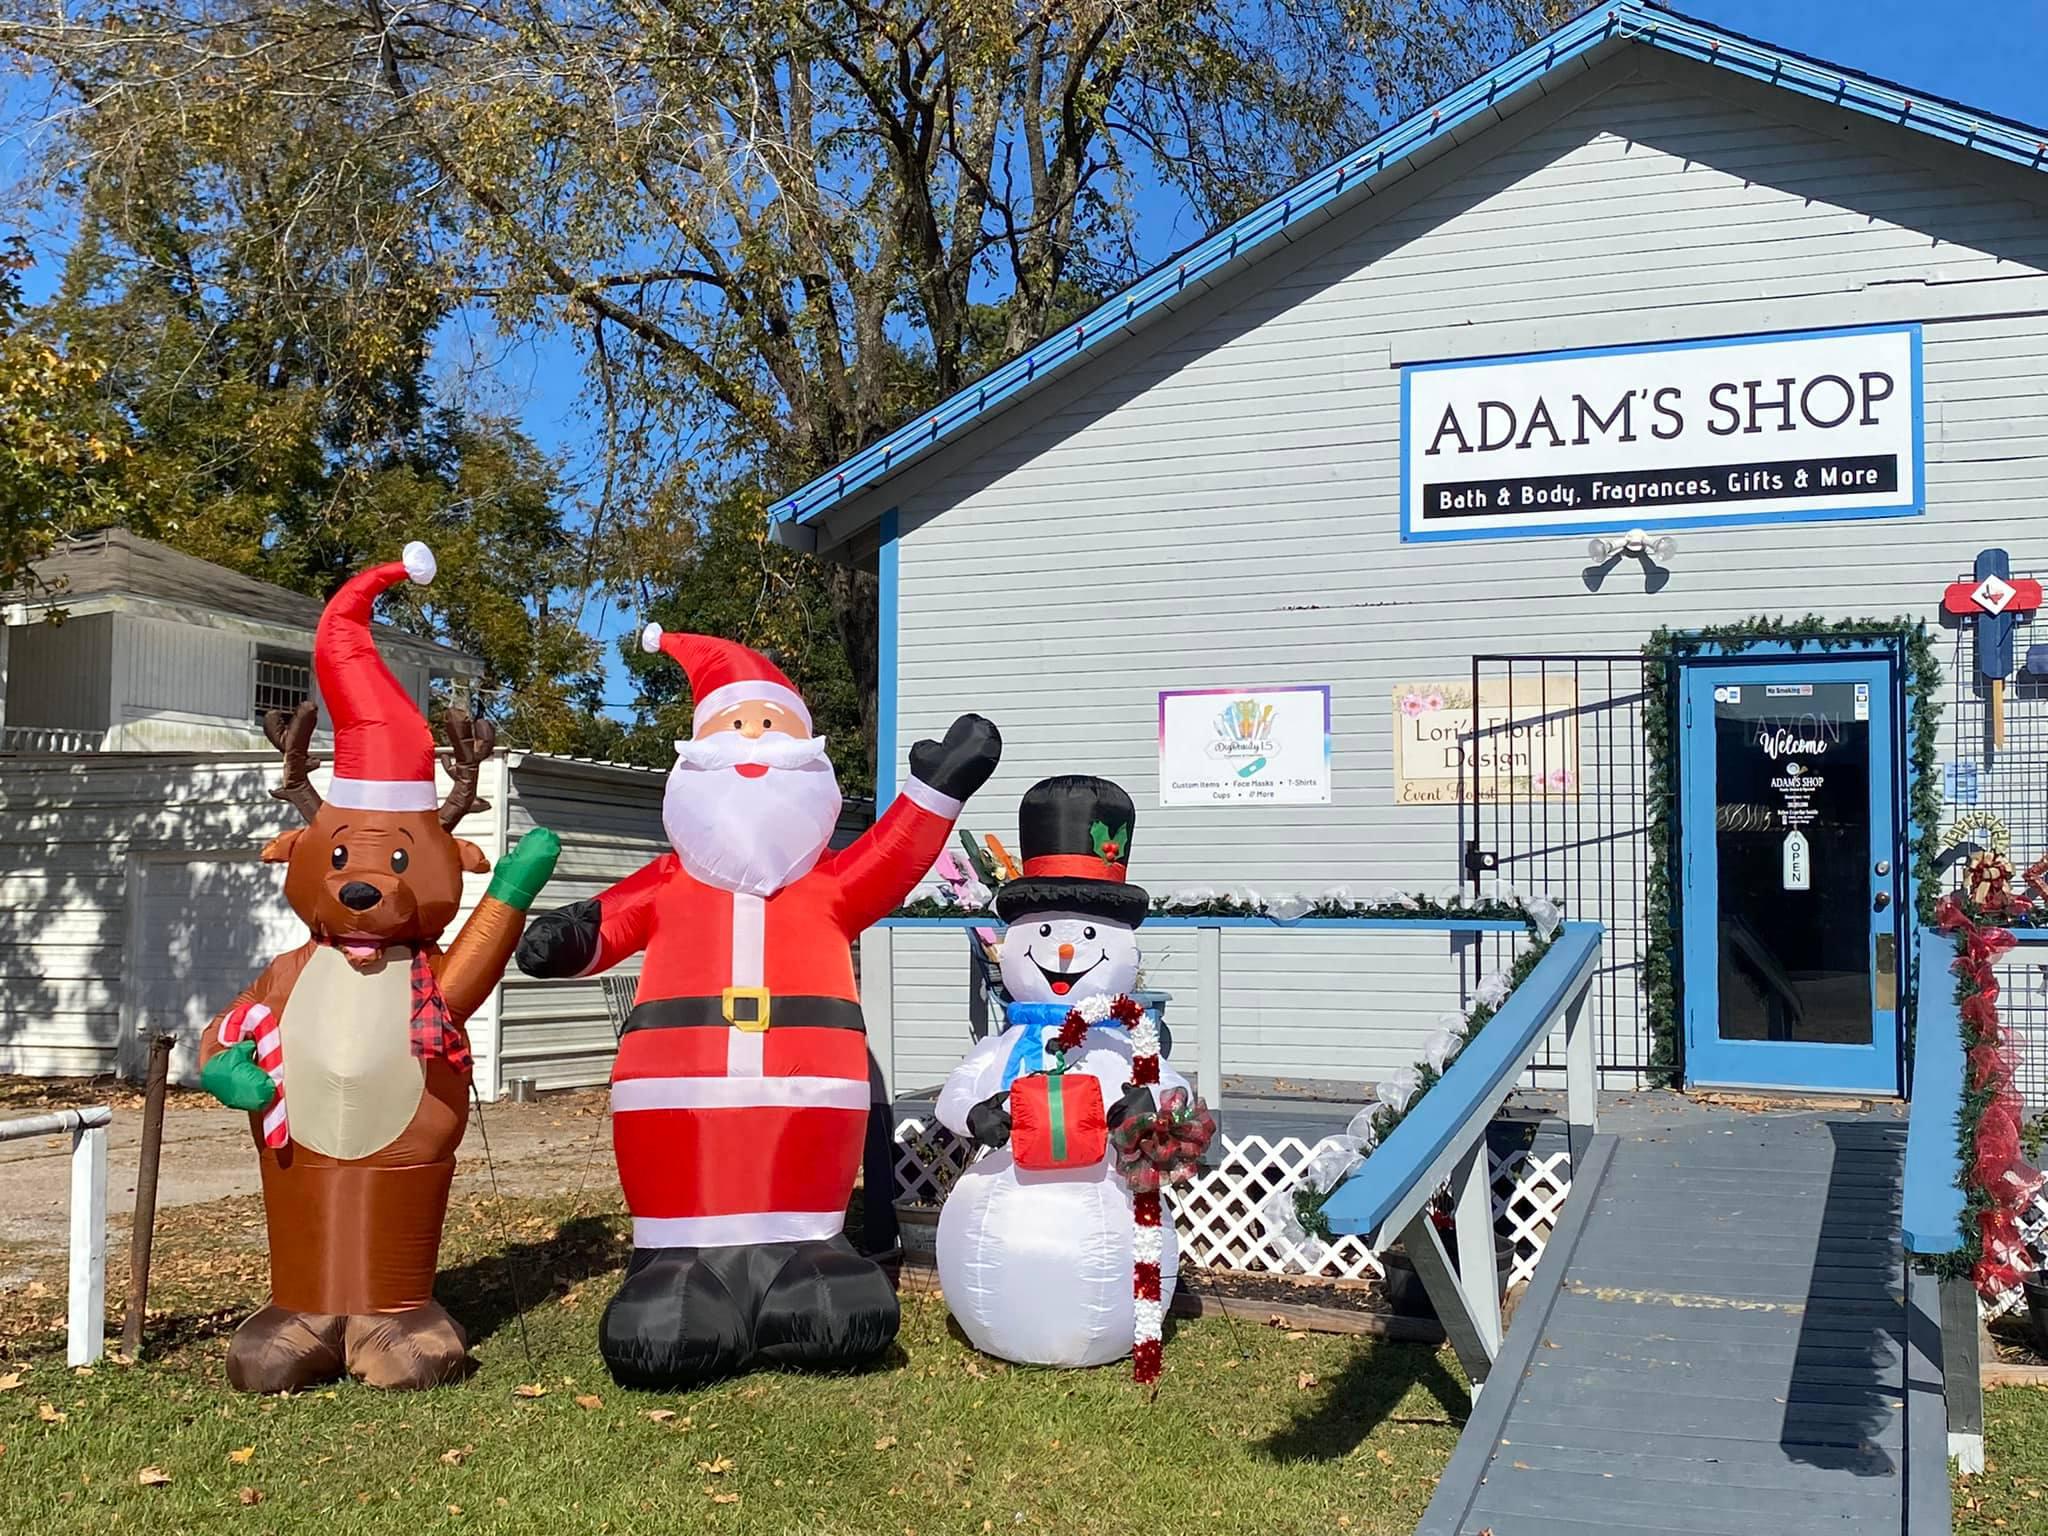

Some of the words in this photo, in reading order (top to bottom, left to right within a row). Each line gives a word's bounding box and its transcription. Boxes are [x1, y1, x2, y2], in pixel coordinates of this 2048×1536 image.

[1424, 386, 1685, 456] ADAM'S
[1706, 370, 1895, 437] SHOP
[1439, 489, 1487, 511] Bath
[1496, 486, 1512, 507] &
[1520, 483, 1582, 509] Body,
[1591, 477, 1718, 504] Fragrances,
[1727, 469, 1784, 494] Gifts
[1793, 467, 1809, 489] &
[1819, 465, 1879, 487] More
[1488, 717, 1555, 739] Floral
[1753, 711, 1840, 745] AVON
[1759, 728, 1828, 760] Welcome
[1444, 746, 1528, 771] Design
[1213, 791, 1230, 799] Cups
[1256, 790, 1275, 799] More
[1233, 780, 1250, 788] Face
[1252, 778, 1274, 787] Masks
[1403, 781, 1441, 802] Event
[1446, 780, 1497, 802] Floist
[1771, 777, 1801, 788] ADAM'S
[1802, 777, 1824, 787] SHOP
[1791, 842, 1801, 883] OPEN
